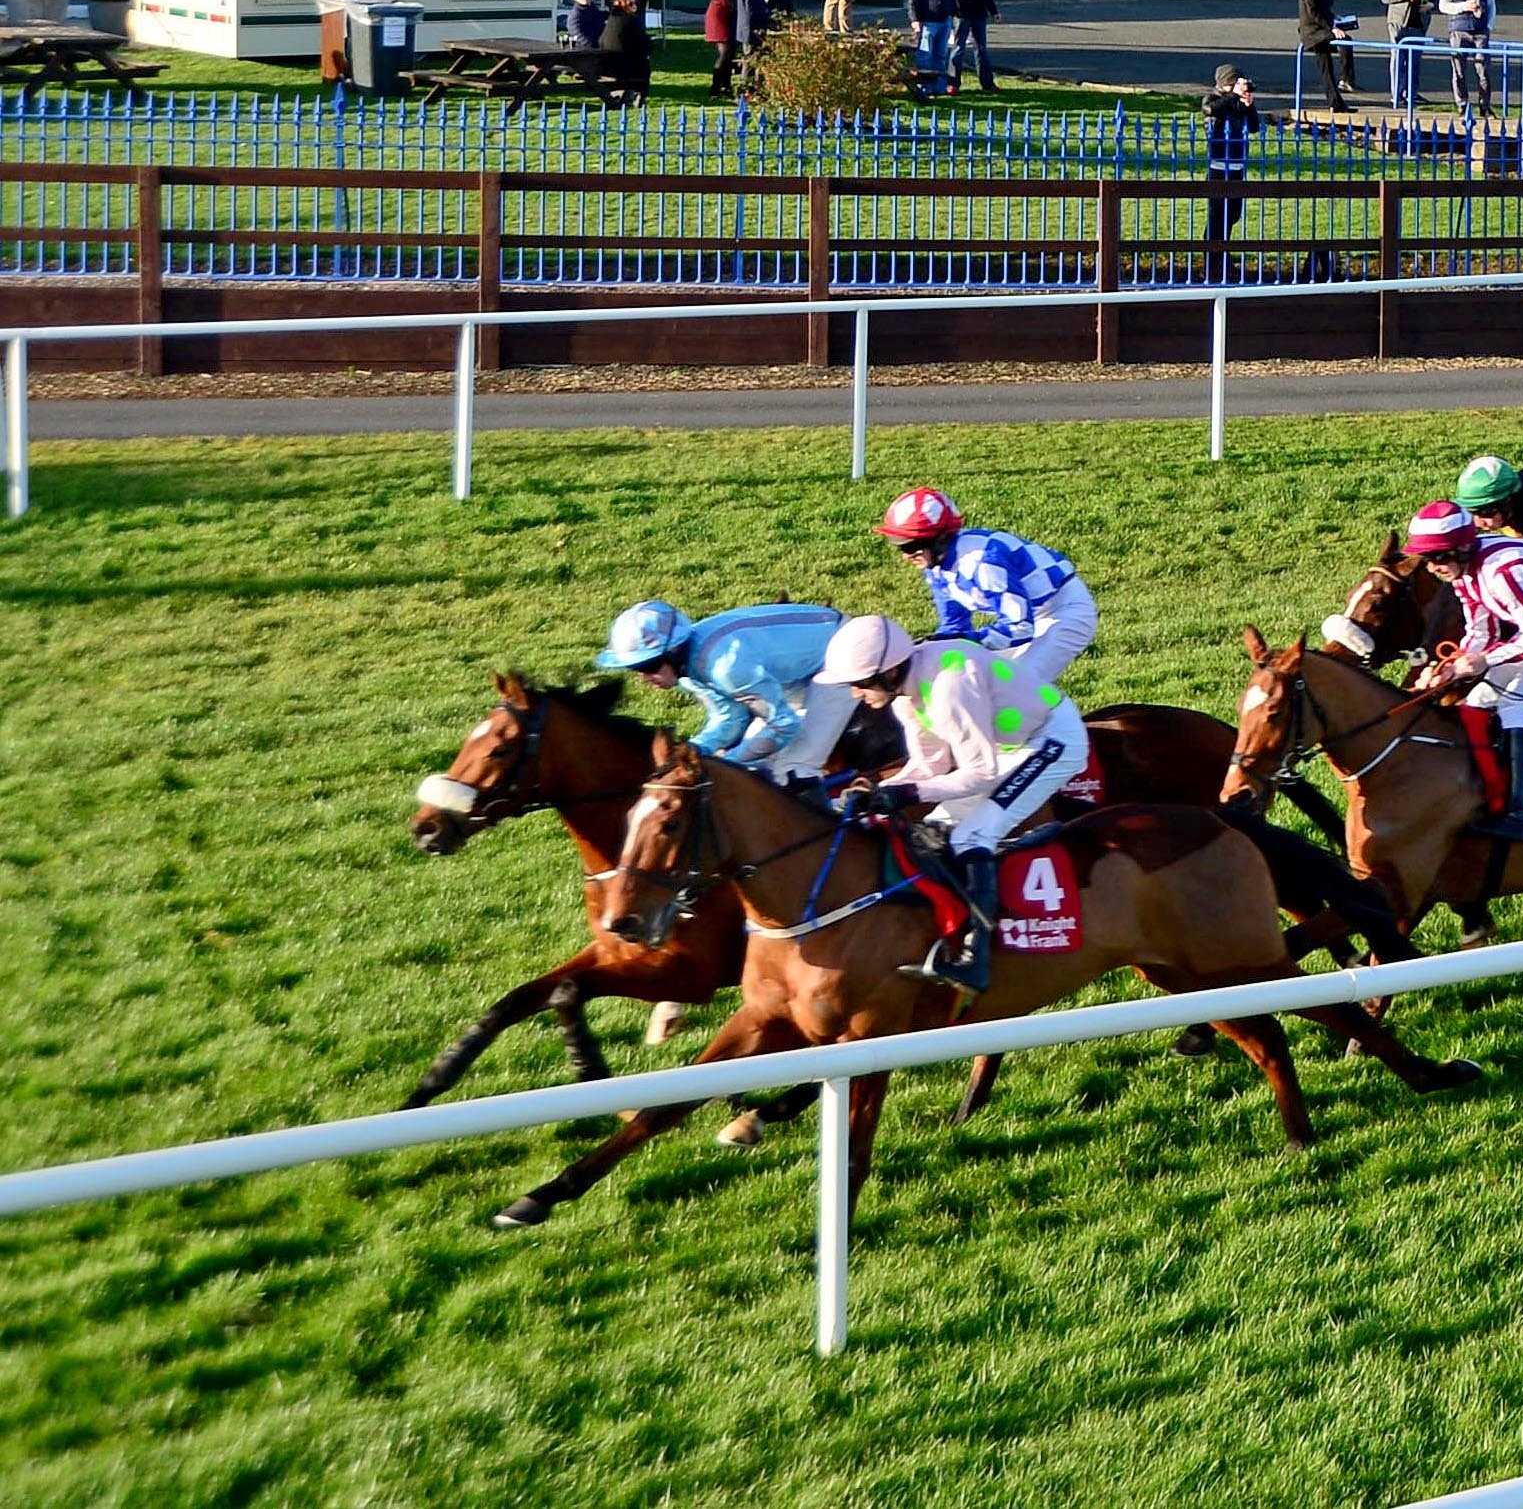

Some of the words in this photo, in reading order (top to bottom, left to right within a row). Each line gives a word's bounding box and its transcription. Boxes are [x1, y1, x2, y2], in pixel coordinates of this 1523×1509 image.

[1022, 857, 1066, 912] 4
[1028, 916, 1077, 934] Knight
[1028, 933, 1071, 948] Frank
